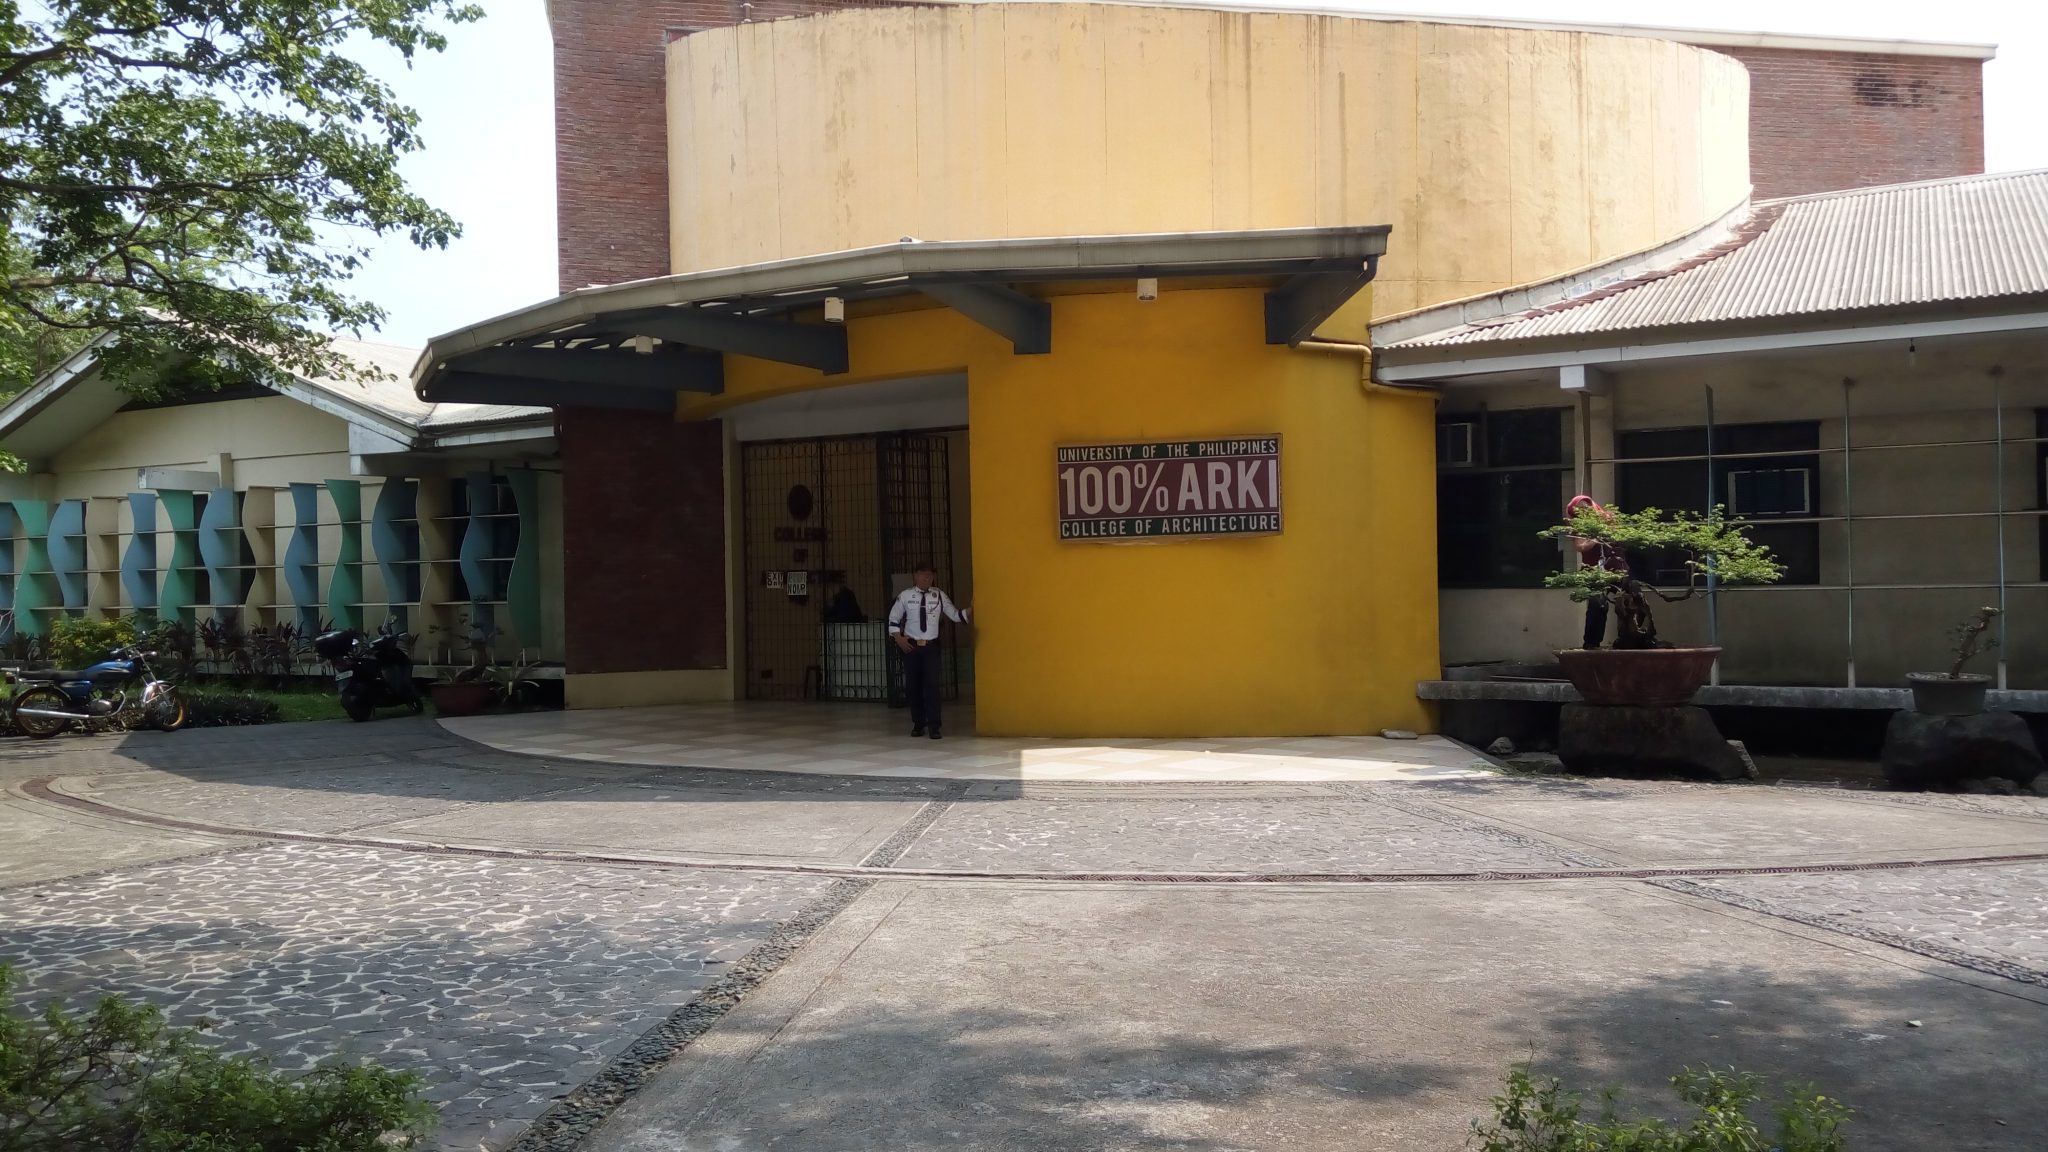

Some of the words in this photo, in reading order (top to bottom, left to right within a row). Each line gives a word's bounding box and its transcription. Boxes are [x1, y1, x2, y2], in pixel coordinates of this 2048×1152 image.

[1060, 446, 1132, 462] UNIVERSITY
[1142, 445, 1156, 459] OF
[1167, 443, 1190, 457] THE
[1199, 440, 1276, 456] PHILIPPINES
[1060, 462, 1169, 516] 100%
[1177, 459, 1278, 511] ARKI
[1062, 520, 1127, 537] COLLEGE
[1135, 519, 1152, 534] OF
[1162, 515, 1278, 533] ARCHITECTURE
